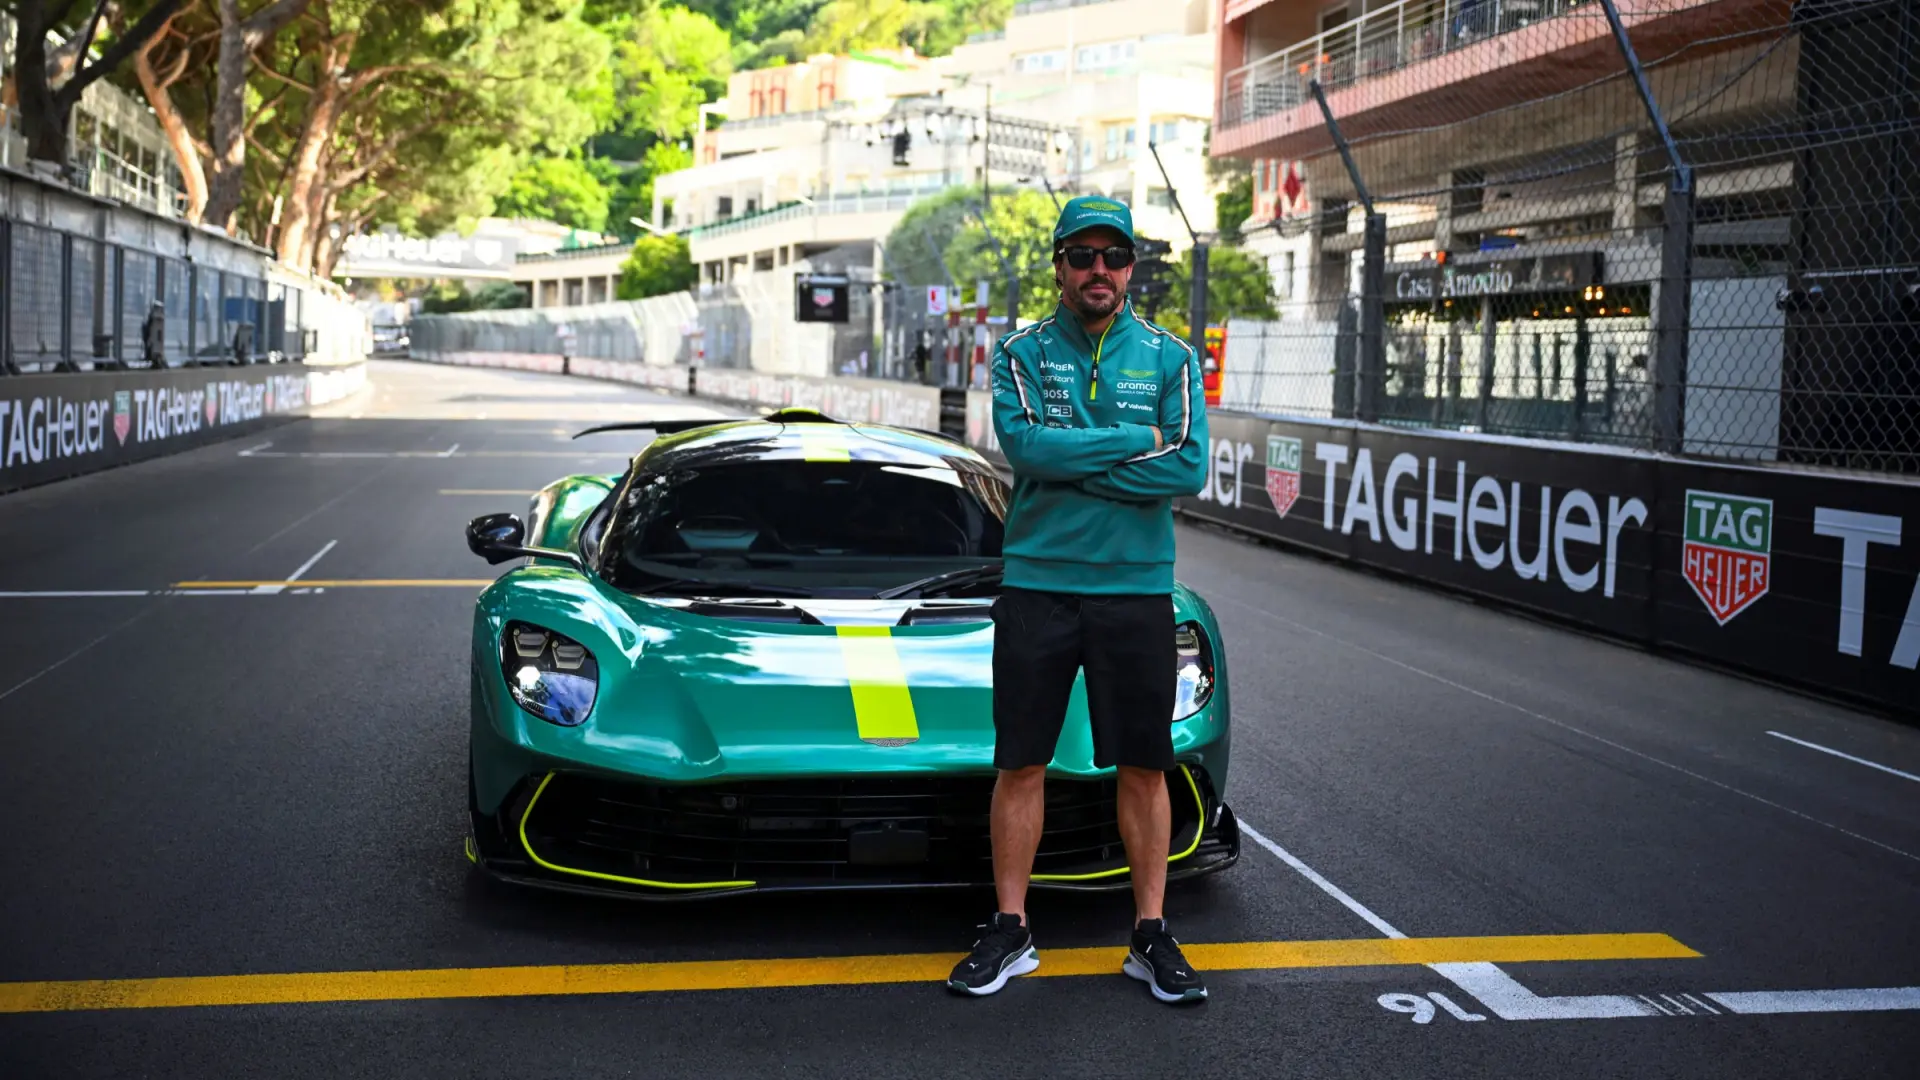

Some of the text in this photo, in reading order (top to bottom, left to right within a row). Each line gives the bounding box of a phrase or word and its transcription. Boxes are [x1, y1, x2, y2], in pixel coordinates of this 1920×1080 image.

[1396, 271, 1432, 298] Casa
[1043, 389, 1069, 399] BOSS
[1117, 382, 1157, 391] aramco
[1269, 440, 1299, 469] TAG
[1267, 472, 1299, 510] HEUER
[1692, 499, 1763, 546] TAG
[1687, 549, 1764, 613] HEUER
